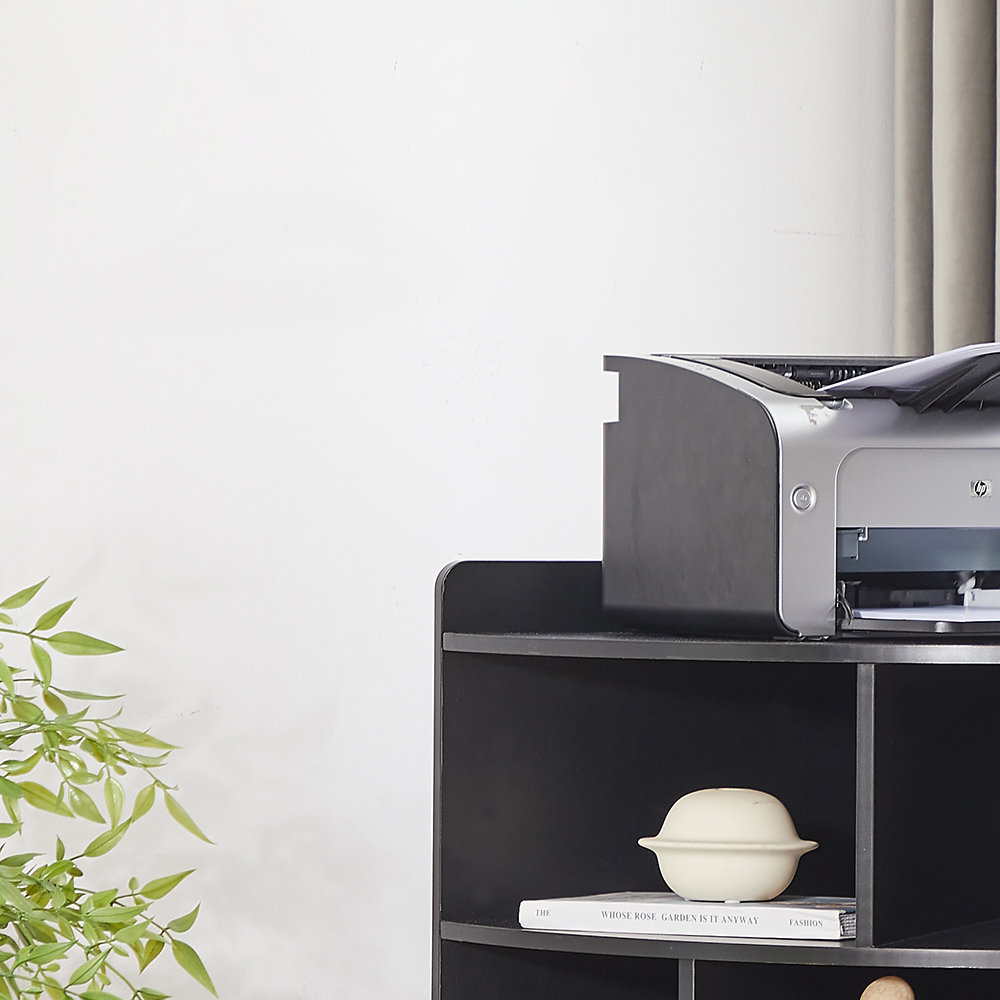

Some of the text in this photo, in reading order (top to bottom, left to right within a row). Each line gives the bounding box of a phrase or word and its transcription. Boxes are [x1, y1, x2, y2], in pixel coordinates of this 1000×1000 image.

[974, 480, 988, 497] hp
[536, 909, 824, 927] THE WHOSE ROSE GARDEN IS IT ANYWAY FASHION
